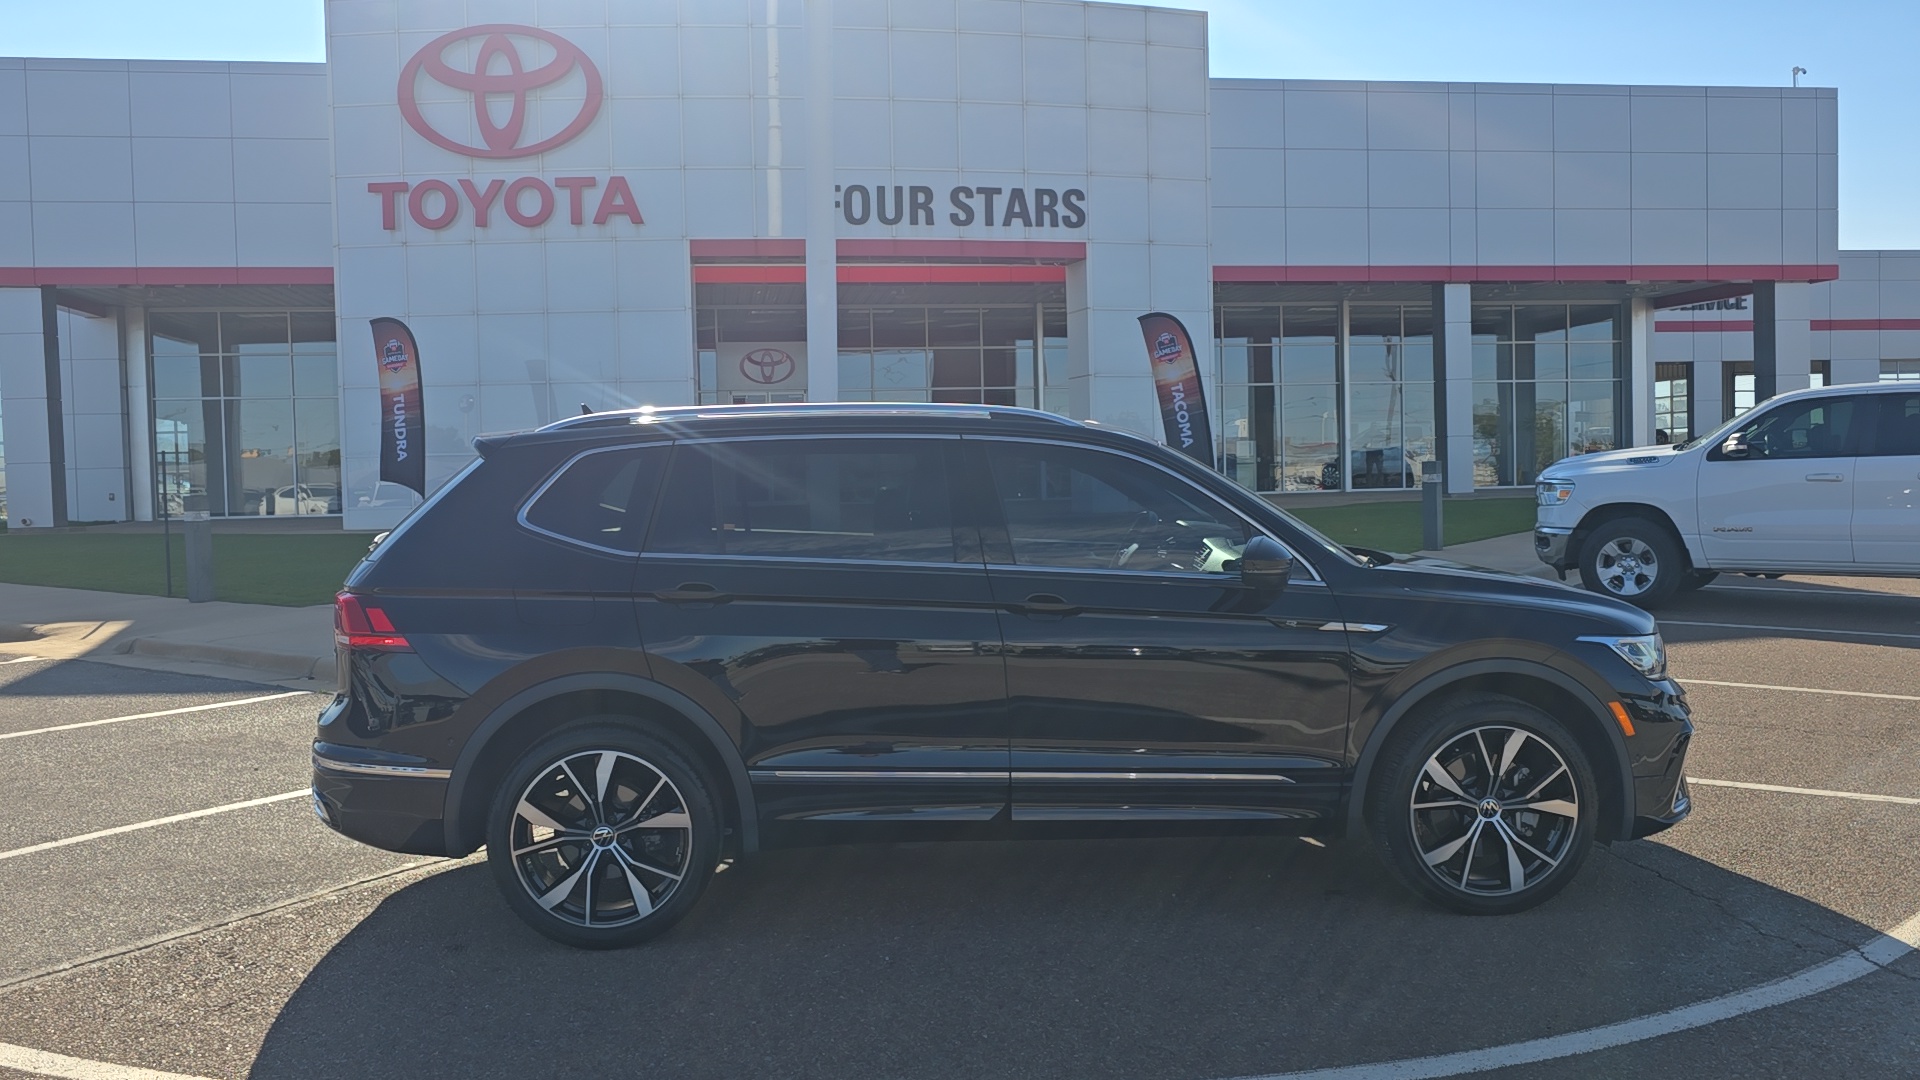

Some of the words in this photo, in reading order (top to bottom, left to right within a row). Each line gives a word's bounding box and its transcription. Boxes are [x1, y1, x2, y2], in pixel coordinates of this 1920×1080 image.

[368, 176, 644, 230] TOYOTA
[949, 186, 1086, 228] STARS
[393, 394, 408, 462] TUNDRA
[1170, 382, 1194, 448] TACOMA
